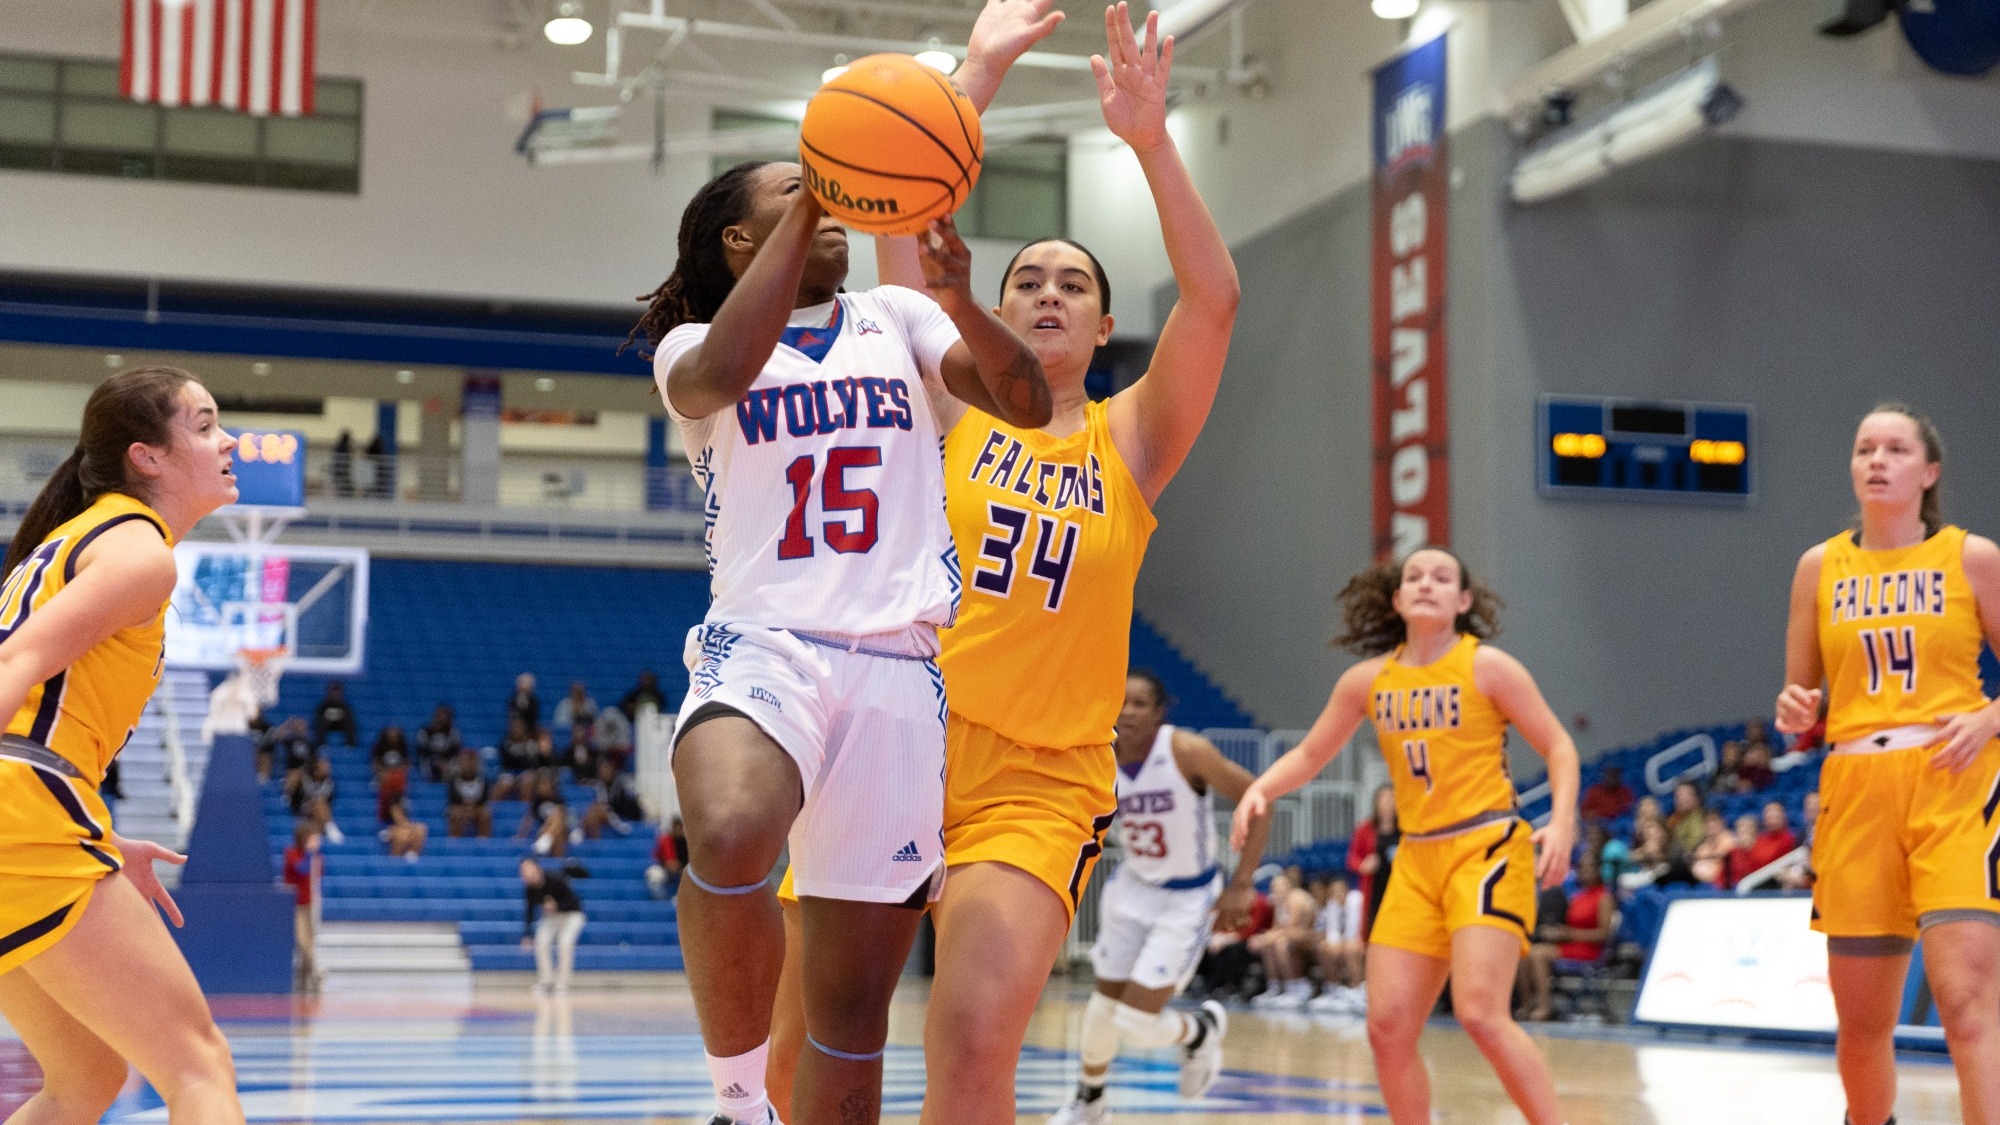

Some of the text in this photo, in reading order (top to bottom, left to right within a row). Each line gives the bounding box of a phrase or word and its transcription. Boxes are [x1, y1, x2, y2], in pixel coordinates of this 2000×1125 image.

[801, 153, 899, 214] Wilson
[736, 376, 913, 446] WOLVES
[968, 428, 1106, 516] FALCONS
[777, 446, 883, 561] 15
[971, 500, 1082, 614] 34
[1832, 568, 1945, 626] FALCONS
[1858, 625, 1916, 696] 14
[1375, 684, 1460, 733] FALCONS
[1402, 739, 1434, 796] 4
[892, 852, 922, 862] adidas
[720, 1089, 750, 1099] adidas
